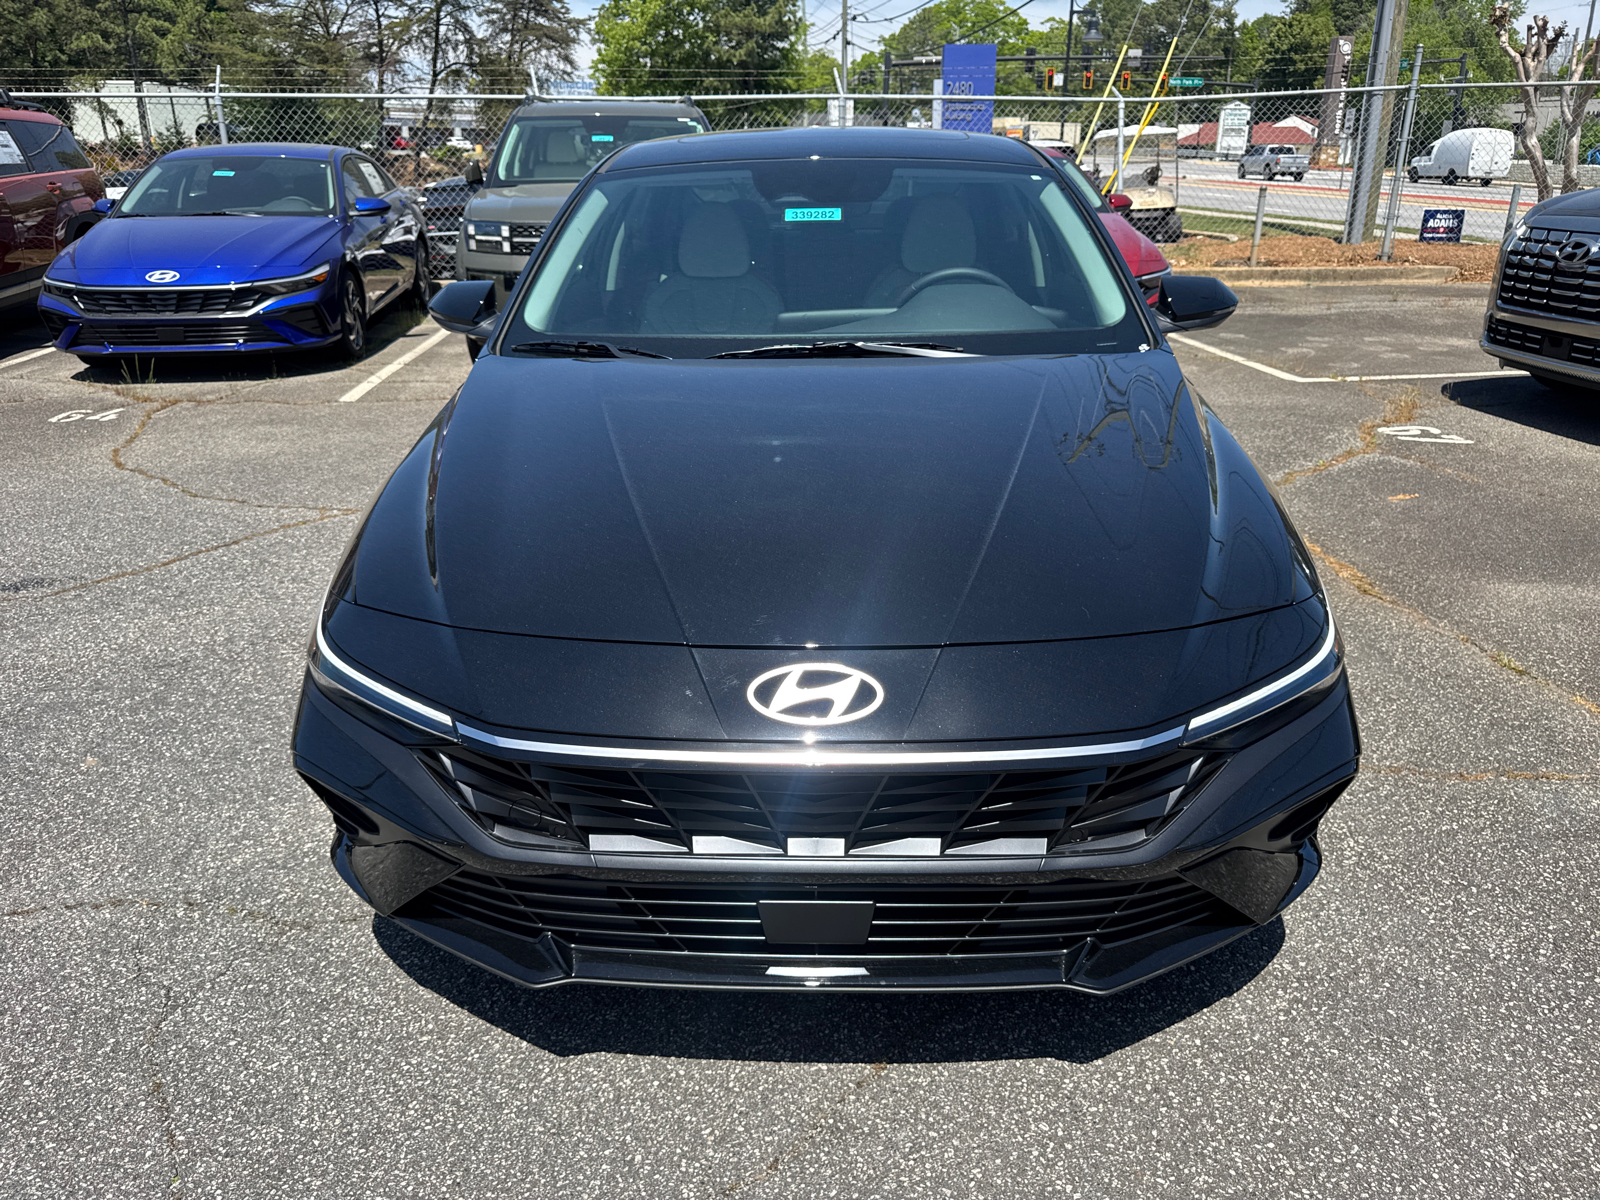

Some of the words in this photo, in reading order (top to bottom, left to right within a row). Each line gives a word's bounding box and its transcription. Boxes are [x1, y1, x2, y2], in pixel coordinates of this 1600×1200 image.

[946, 81, 974, 97] 2480
[791, 210, 835, 219] 339282
[1427, 219, 1459, 228] ADAMS
